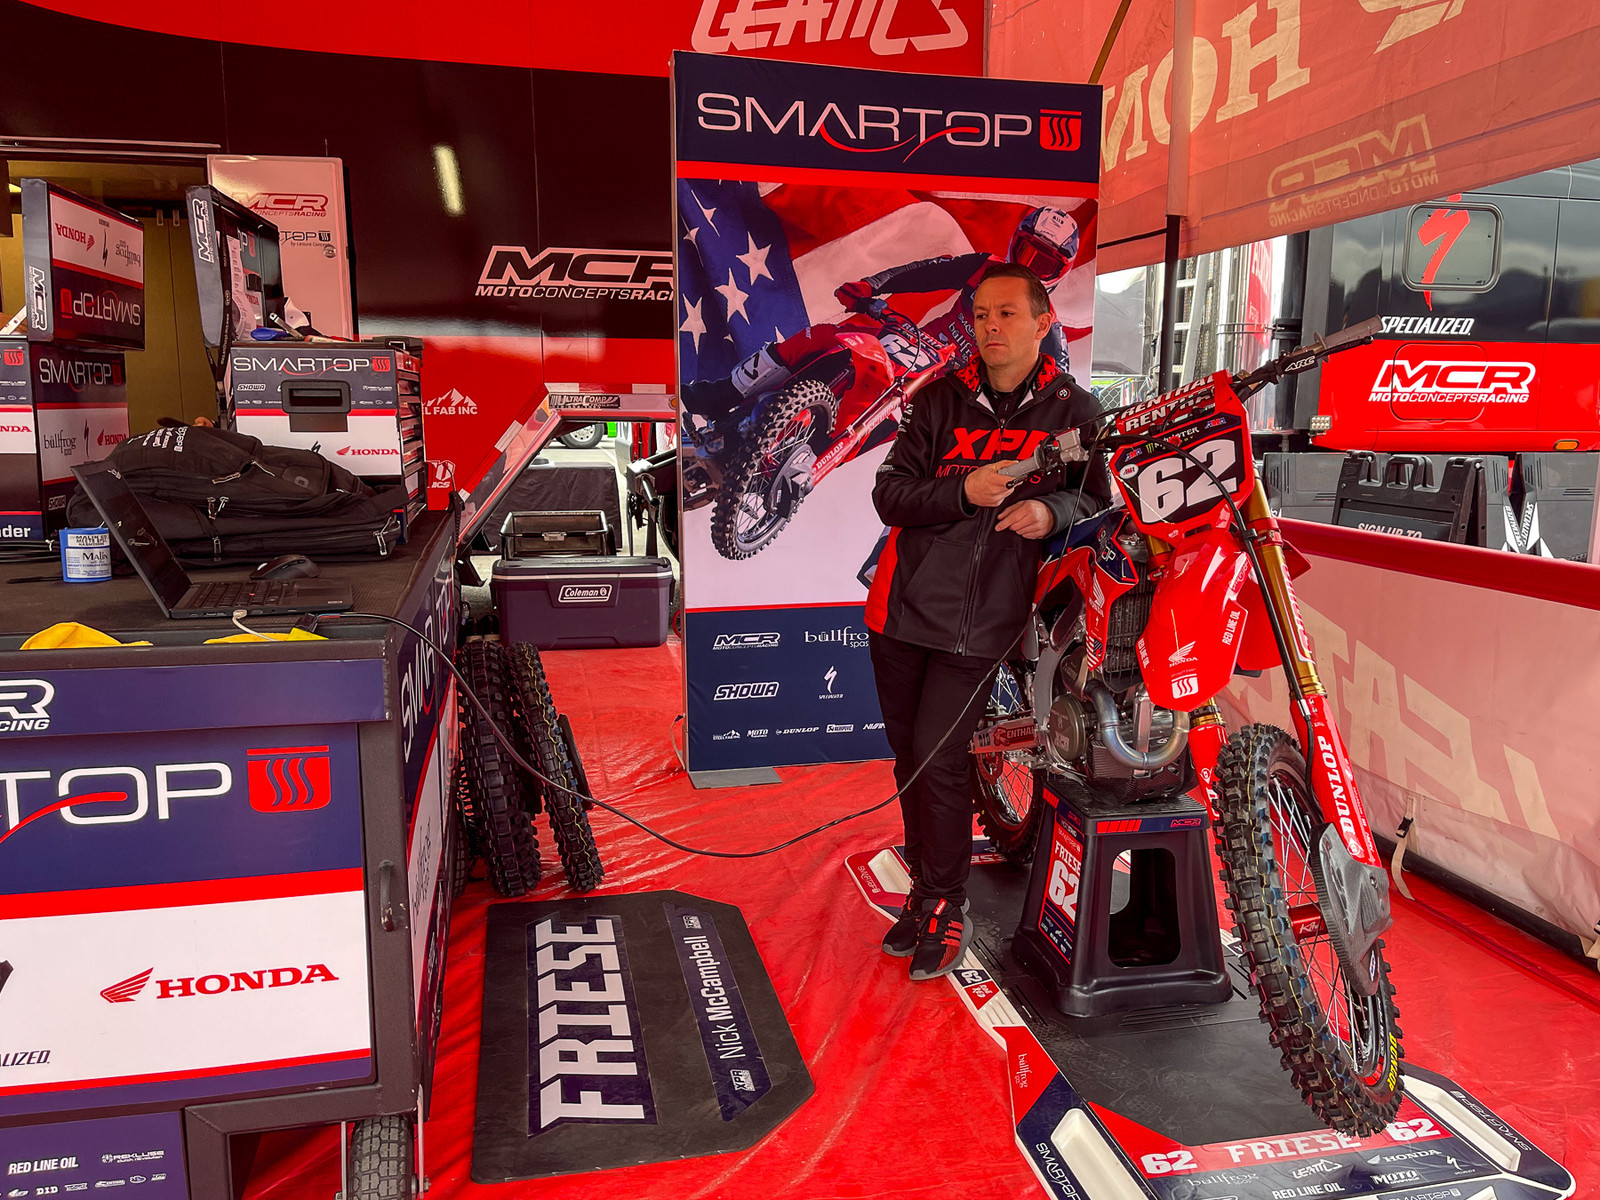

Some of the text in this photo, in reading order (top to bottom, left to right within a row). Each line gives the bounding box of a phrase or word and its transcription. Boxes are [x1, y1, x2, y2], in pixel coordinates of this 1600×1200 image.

[697, 92, 1032, 149] SMARTOP
[55, 223, 87, 244] HONDA
[192, 198, 211, 263] MCR
[33, 267, 47, 331] MCR
[475, 285, 674, 301] MOTOCONCEPTSRACI
[73, 292, 141, 326] SMARTOP
[39, 358, 112, 385] SMARTOP
[233, 357, 370, 373] SMARTOP
[1284, 355, 1317, 372] ARC
[1372, 359, 1537, 394] MCR
[1368, 392, 1529, 404] MOTOCONCEPTSRACING
[433, 406, 456, 415] FAB
[458, 406, 478, 415] INC
[351, 448, 399, 456] HONDA
[815, 441, 845, 470] DUNLOP
[1137, 439, 1238, 524] 62
[0, 523, 32, 538] der
[564, 588, 599, 598] Coleman
[804, 626, 869, 646] bullfro
[1222, 610, 1241, 645] RED LINE OIL
[713, 632, 781, 648] MCR
[849, 640, 869, 649] spas
[1168, 656, 1199, 668] HONDA
[713, 682, 780, 701] SHOWA
[782, 726, 820, 735] DUNLOP
[1317, 735, 1356, 835] DUNLOP
[1170, 818, 1202, 828] MCR
[1055, 839, 1082, 877] FRIESE
[1049, 859, 1080, 923] 62
[156, 963, 339, 999] HONDA
[961, 970, 983, 985] 62
[683, 935, 746, 1061] Nick McCampbell
[535, 919, 646, 1129] FRIESE
[1387, 1031, 1398, 1092] DUNLOP
[1140, 1118, 1442, 1175] 62 FRIESE 62
[1384, 1149, 1442, 1163] HONDA
[7, 1156, 79, 1175] RED LINE OIL
[1371, 1170, 1418, 1185] MOTO
[1272, 1182, 1346, 1200] RED LINE OIL
